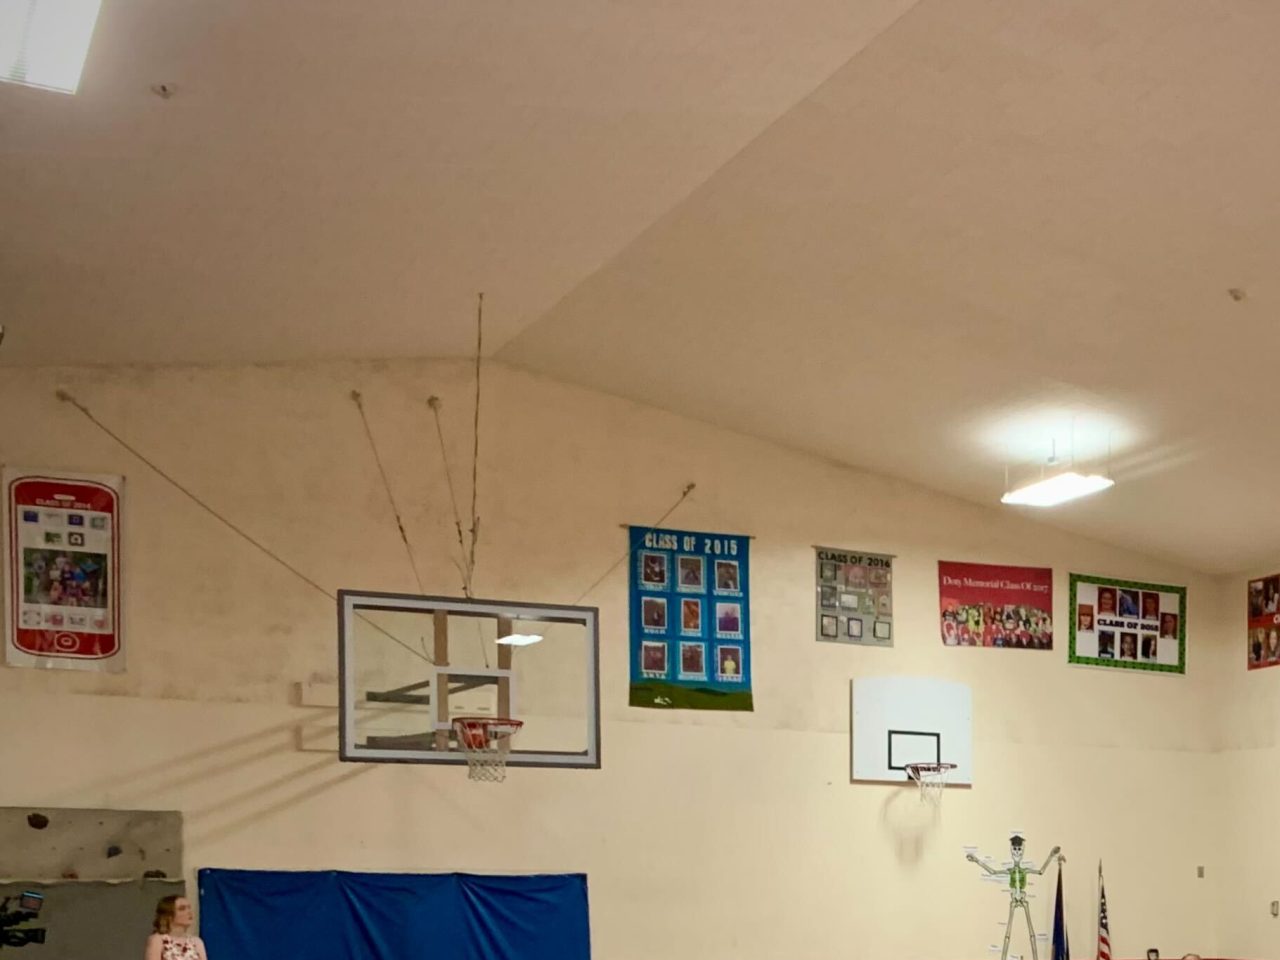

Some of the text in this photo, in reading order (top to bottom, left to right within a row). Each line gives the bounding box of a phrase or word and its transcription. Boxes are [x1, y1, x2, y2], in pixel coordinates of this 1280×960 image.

[645, 532, 738, 556] CLASS OF 2015
[818, 551, 891, 568] CLASS OF 2016
[963, 577, 999, 588] Memorial
[1097, 618, 1124, 628] CLASS
